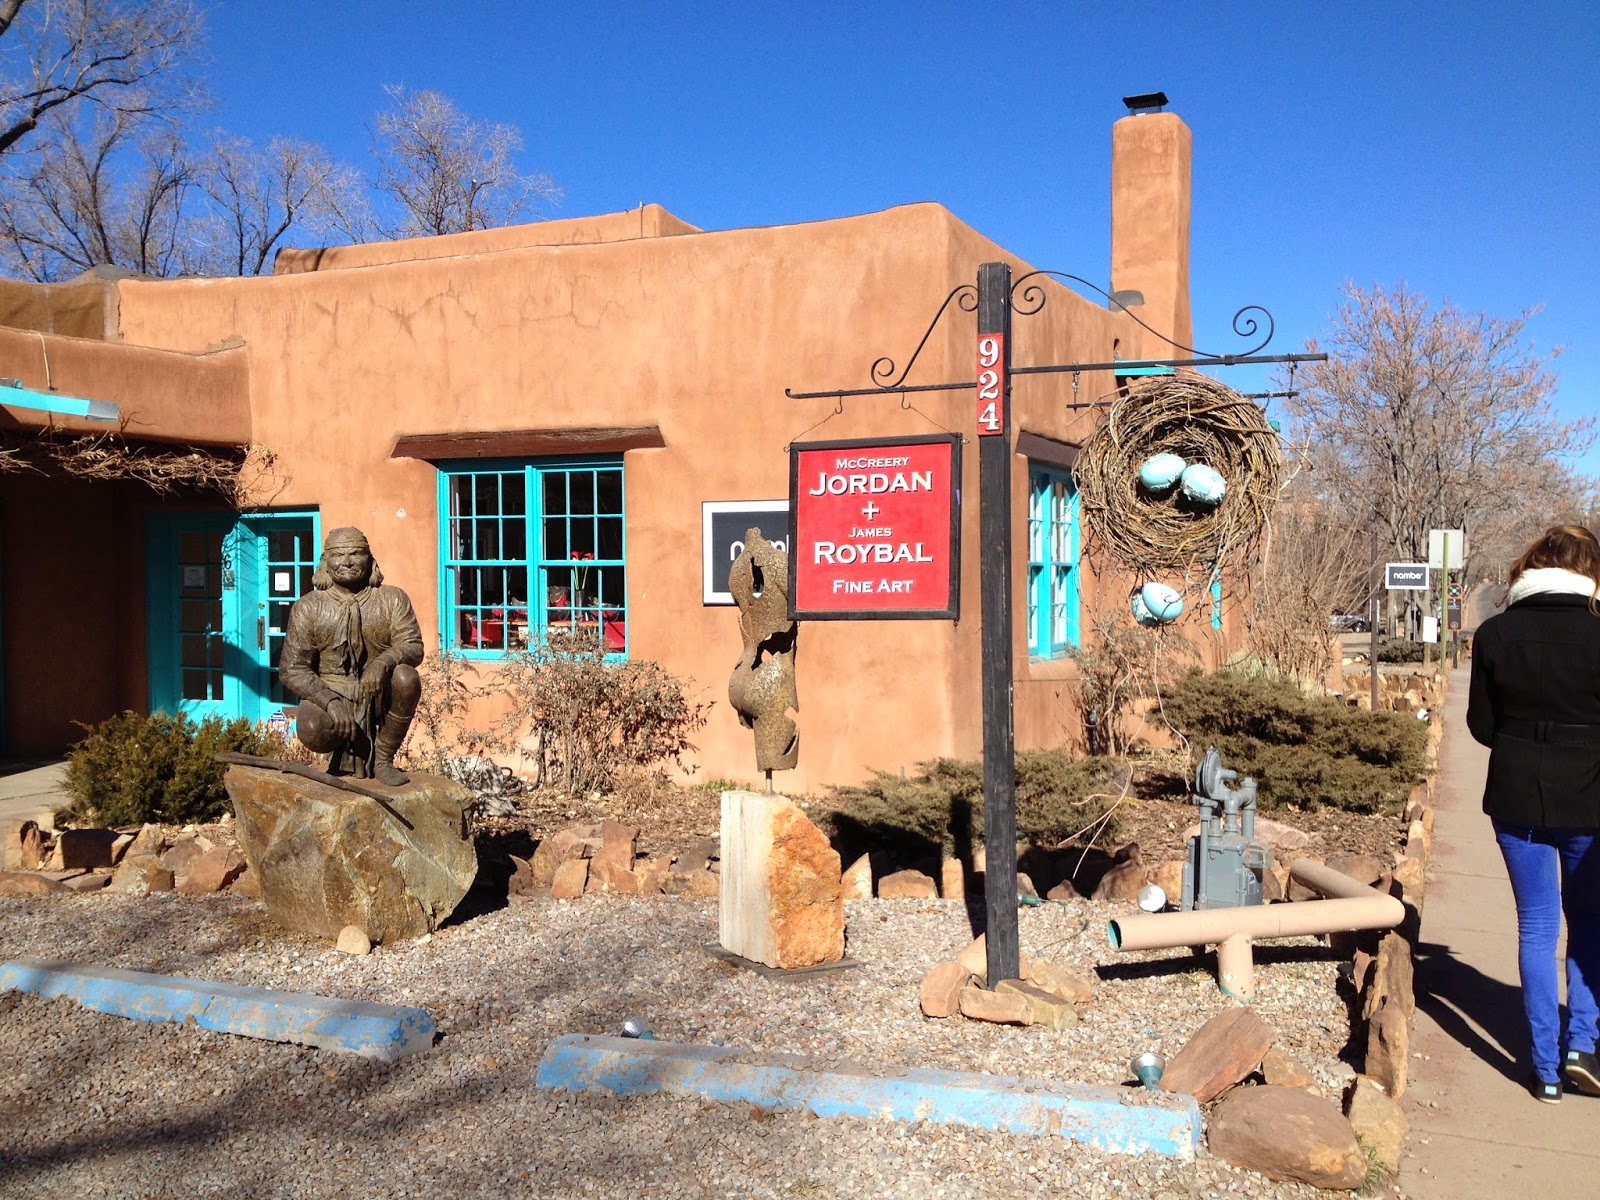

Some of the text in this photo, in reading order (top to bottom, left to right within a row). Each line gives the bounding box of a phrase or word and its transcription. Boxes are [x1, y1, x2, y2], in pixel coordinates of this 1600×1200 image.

[978, 338, 999, 431] 924
[836, 456, 911, 470] McCREERY
[809, 470, 933, 496] JORDAN
[848, 527, 892, 538] JAMES
[813, 541, 933, 565] ROYBAL
[832, 578, 914, 594] FINE ART
